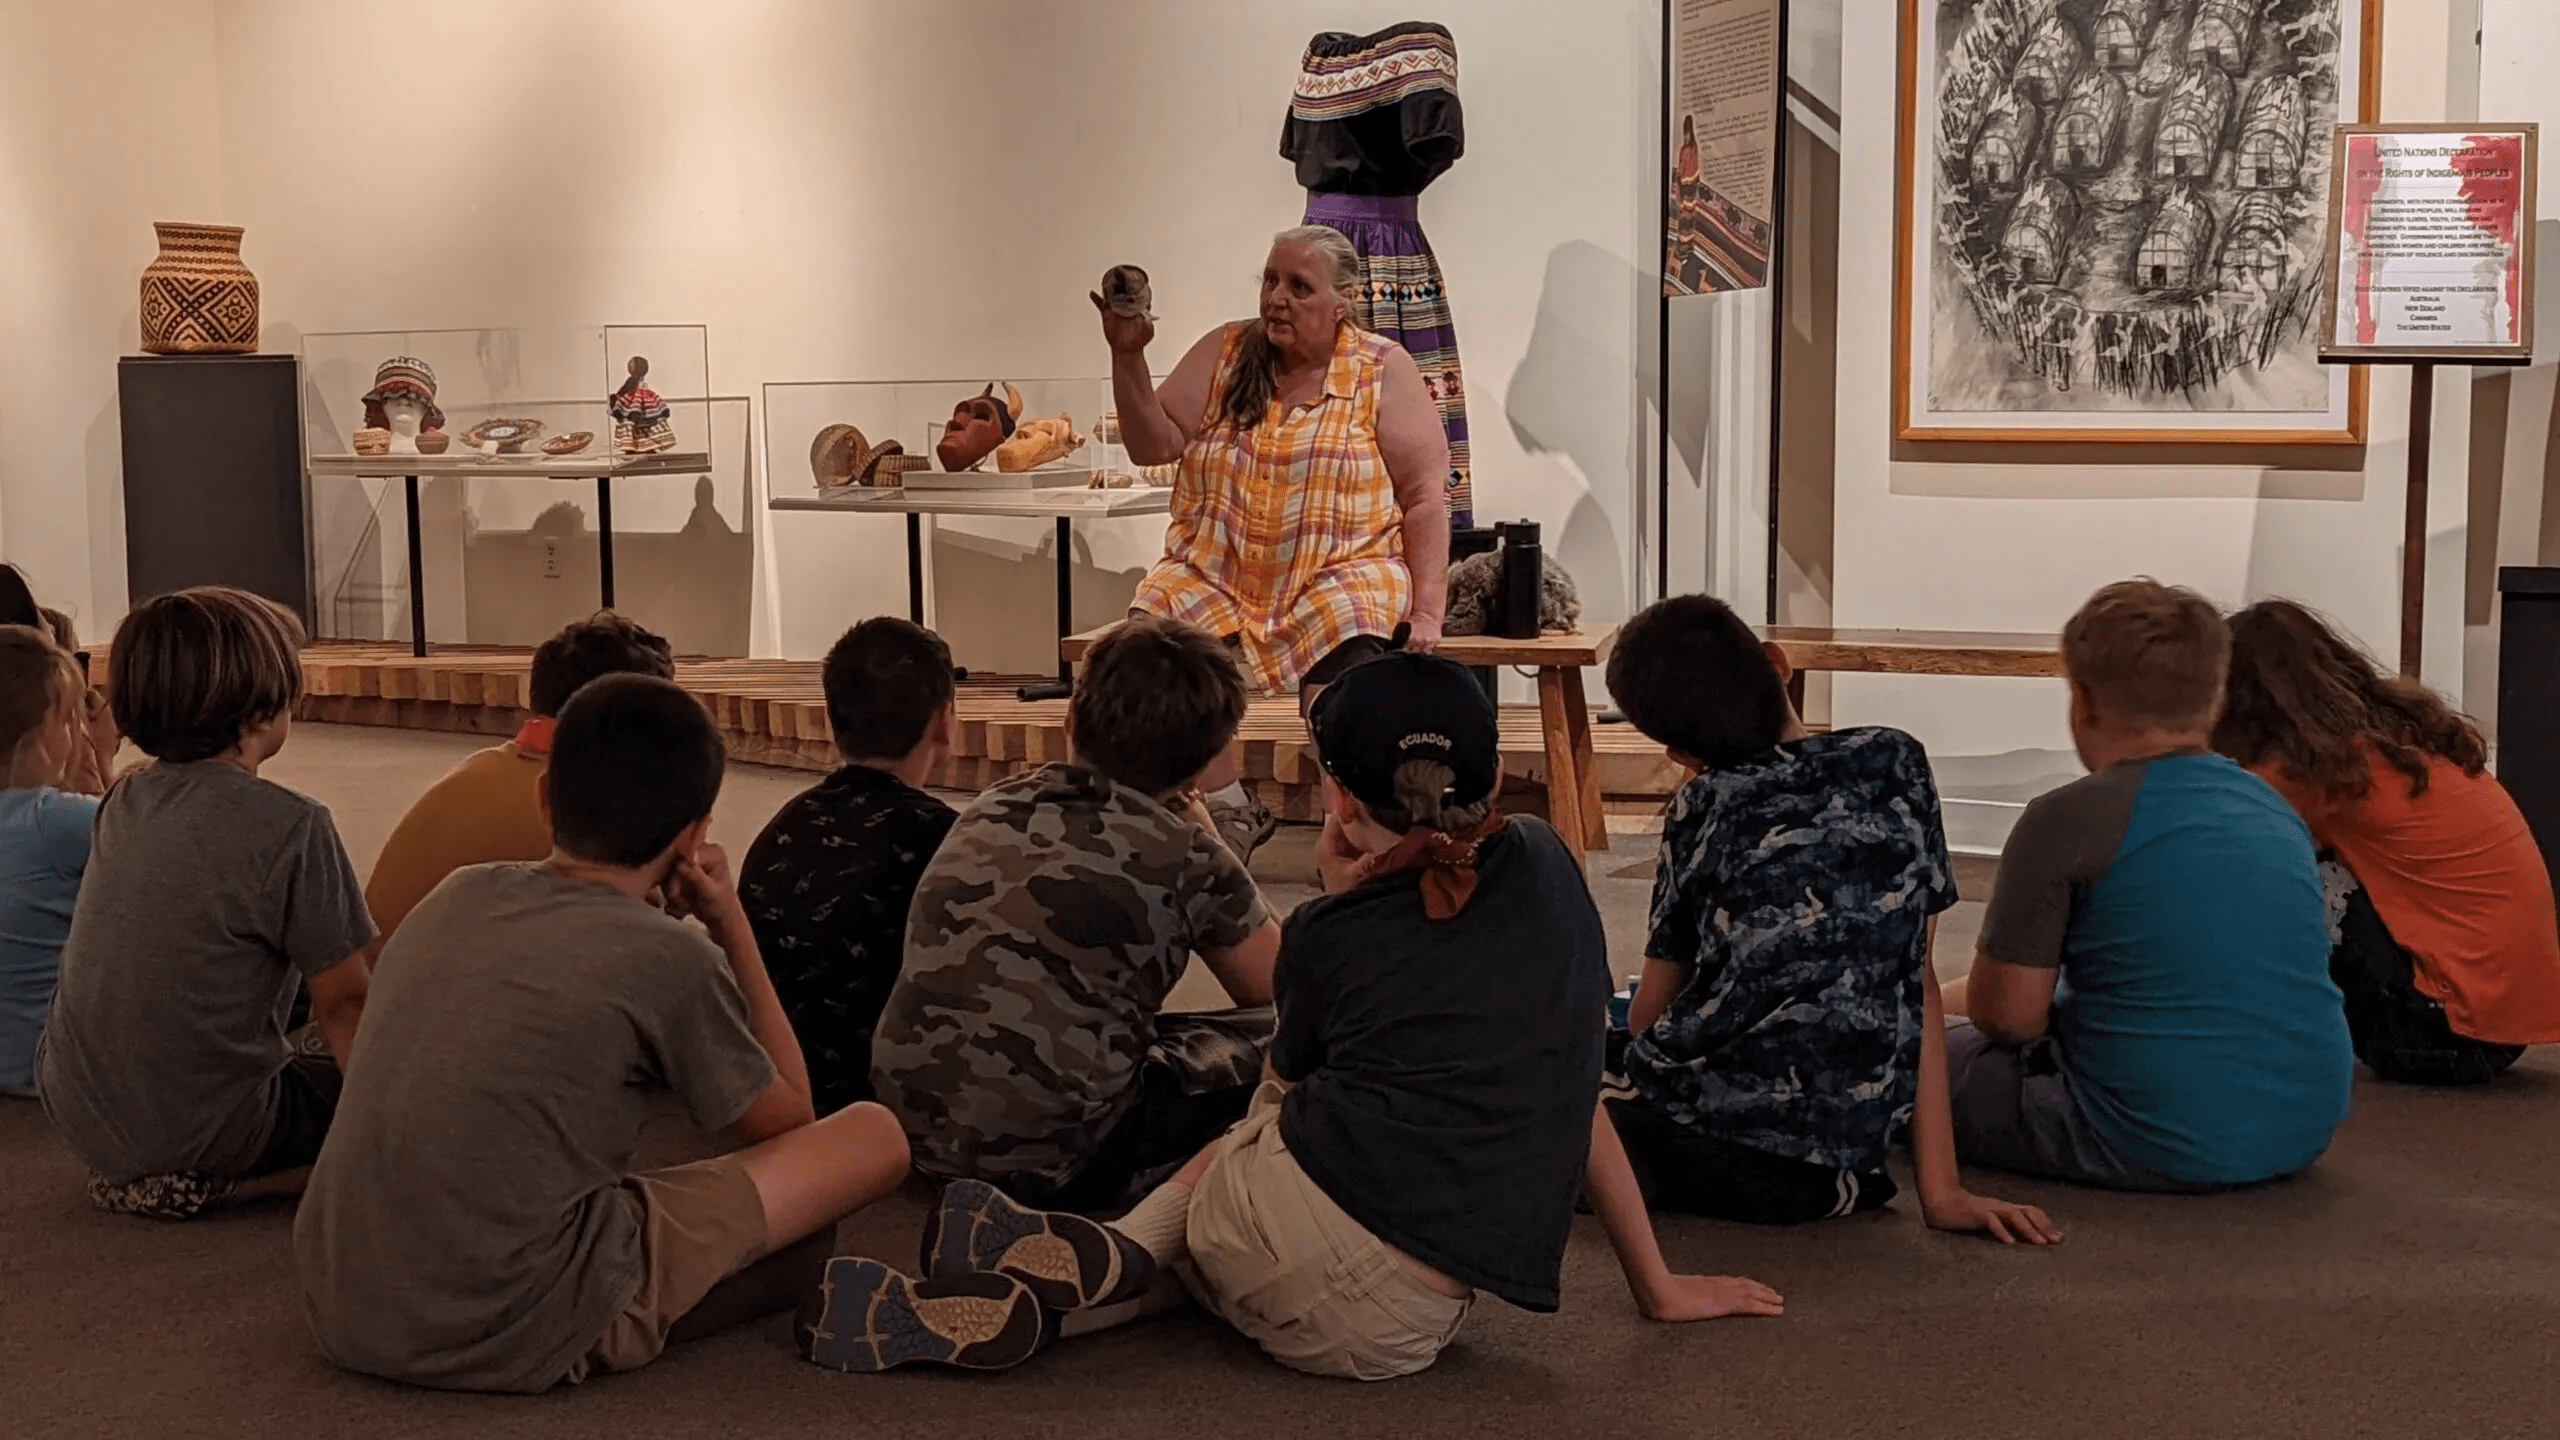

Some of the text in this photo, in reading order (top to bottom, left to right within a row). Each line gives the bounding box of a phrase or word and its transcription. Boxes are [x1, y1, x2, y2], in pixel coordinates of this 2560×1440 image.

[2404, 147, 2437, 157] NATIONS
[2439, 147, 2493, 157] DECLARATION
[2385, 168, 2413, 178] RIGHTS
[2414, 169, 2425, 178] OF
[2426, 168, 2472, 178] INDIGENOUS
[2474, 167, 2509, 178] PEOPLES
[1398, 732, 1453, 751] ECUADOR
